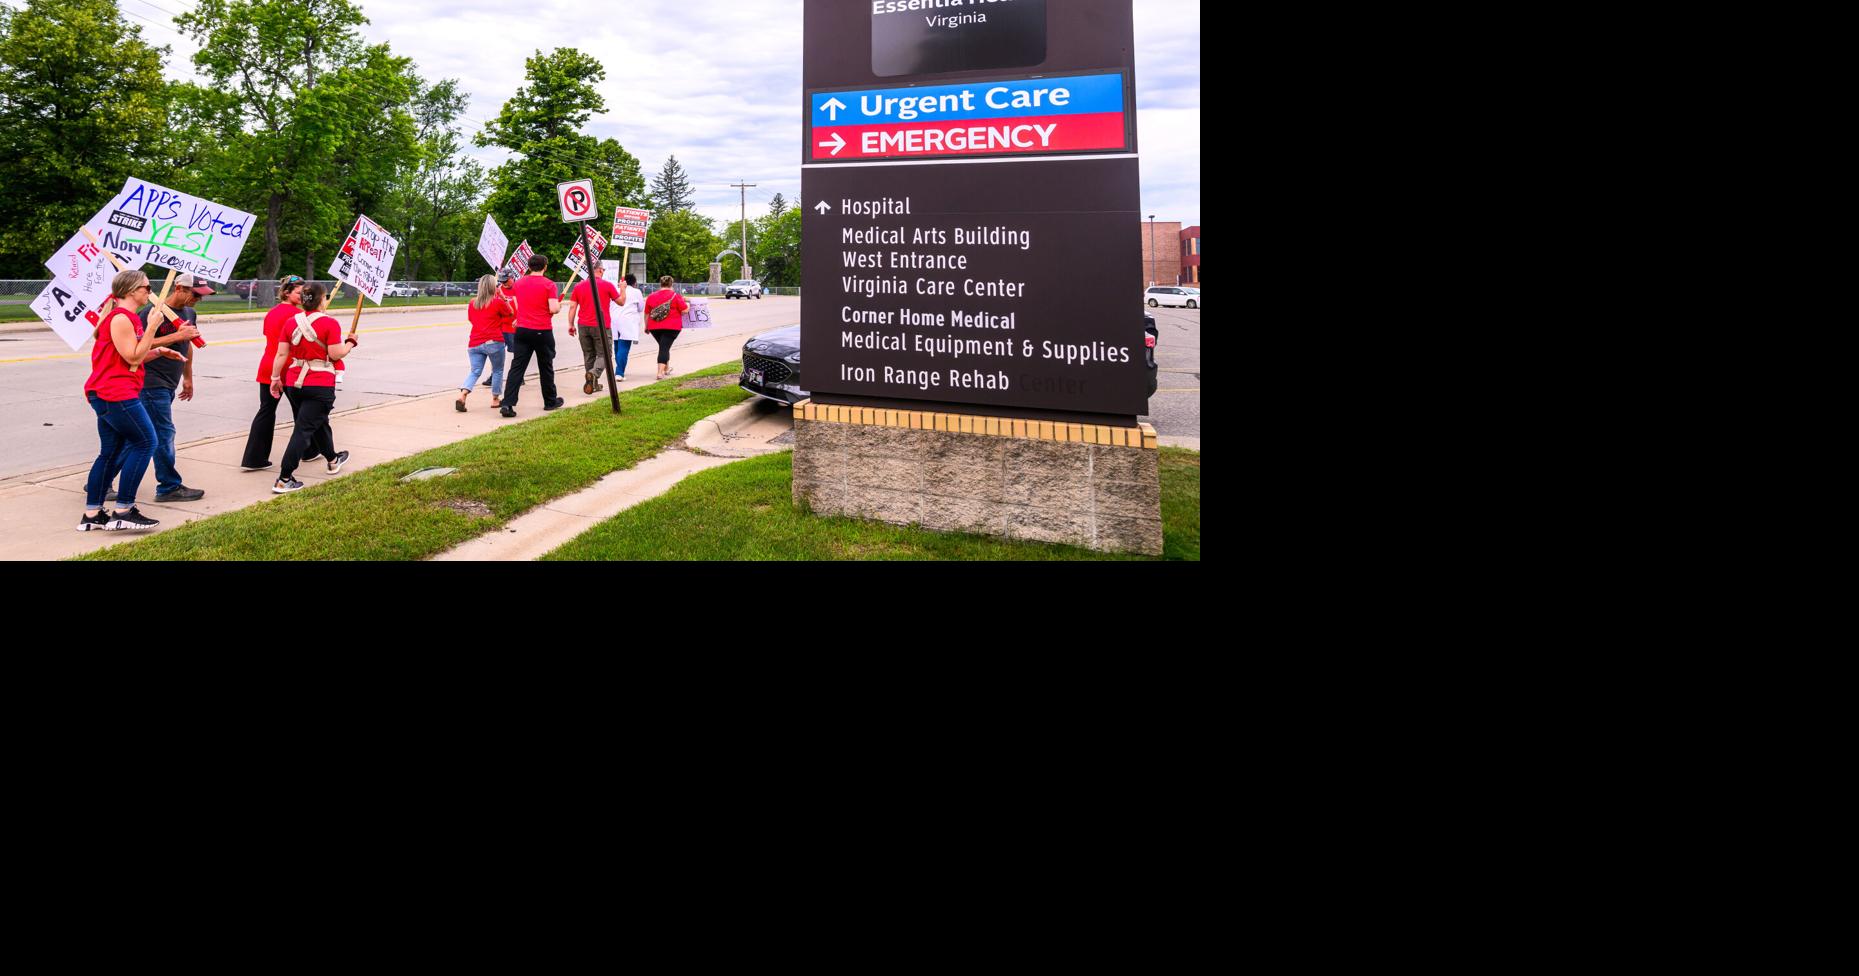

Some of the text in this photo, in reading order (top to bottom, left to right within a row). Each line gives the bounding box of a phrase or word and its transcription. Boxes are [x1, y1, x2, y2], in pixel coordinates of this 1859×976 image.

[925, 11, 987, 28] Virginia
[861, 86, 1071, 120] Urgent Care
[861, 123, 1058, 154] EMERGENCY
[842, 197, 911, 219] Hospital
[111, 213, 144, 230] STRIKE
[361, 221, 380, 247] Drop
[149, 218, 214, 257] YES!
[842, 226, 1030, 250] Medical Arts Building
[146, 244, 230, 280] Recognize!
[842, 251, 967, 269] West Entrance
[842, 274, 1025, 298] Virginia Care Center
[842, 306, 1015, 329] Corner Home Medical
[842, 331, 1130, 365] Medical Equipment & Supplies
[841, 364, 875, 382] Iron
[884, 366, 941, 390] Range
[949, 370, 1010, 390] Rehab
